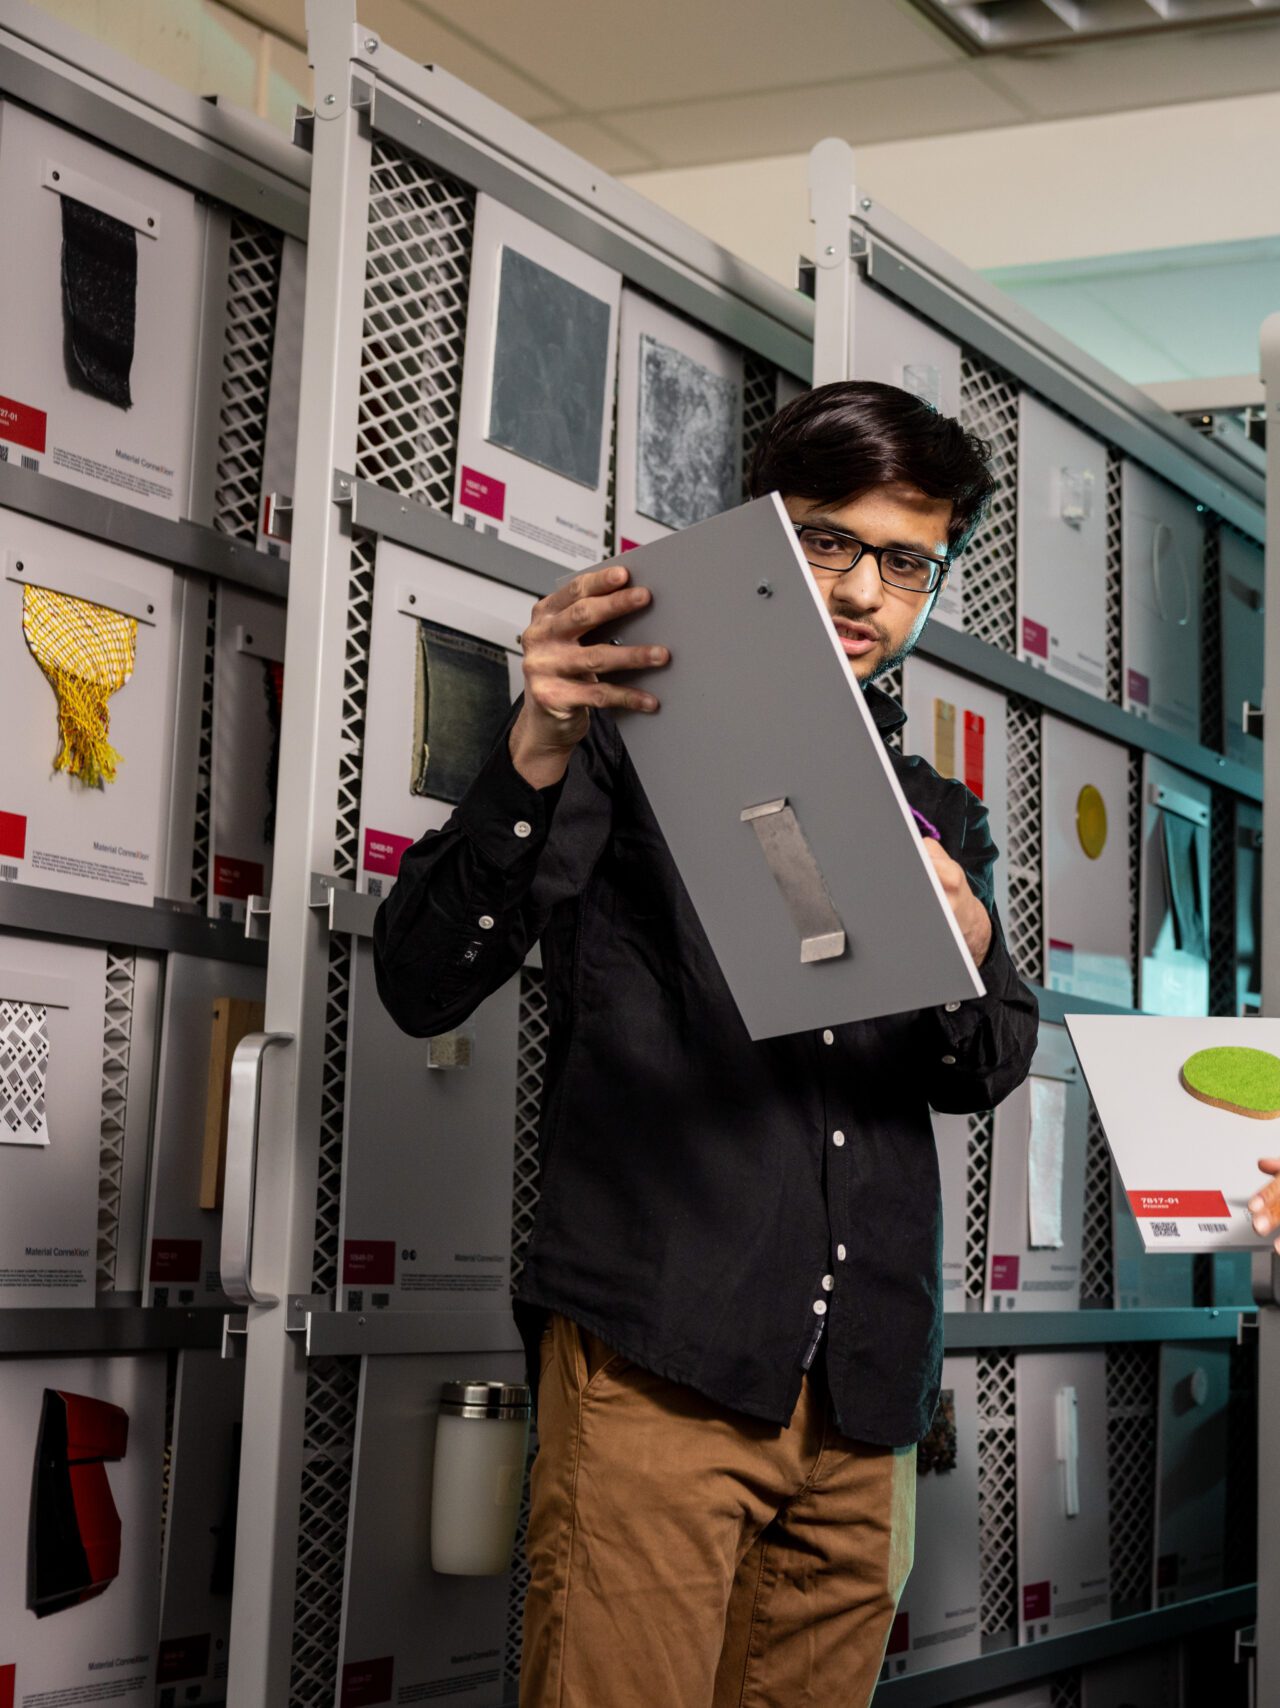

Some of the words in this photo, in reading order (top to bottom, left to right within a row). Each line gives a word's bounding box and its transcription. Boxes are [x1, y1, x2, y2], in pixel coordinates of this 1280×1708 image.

[0, 407, 18, 422] 27-01
[115, 448, 141, 465] Material
[93, 841, 118, 855] Material
[1140, 1197, 1180, 1205] 7817-01
[25, 1247, 53, 1257] Material
[53, 1247, 89, 1257] ConneXion
[88, 1659, 115, 1671] Material
